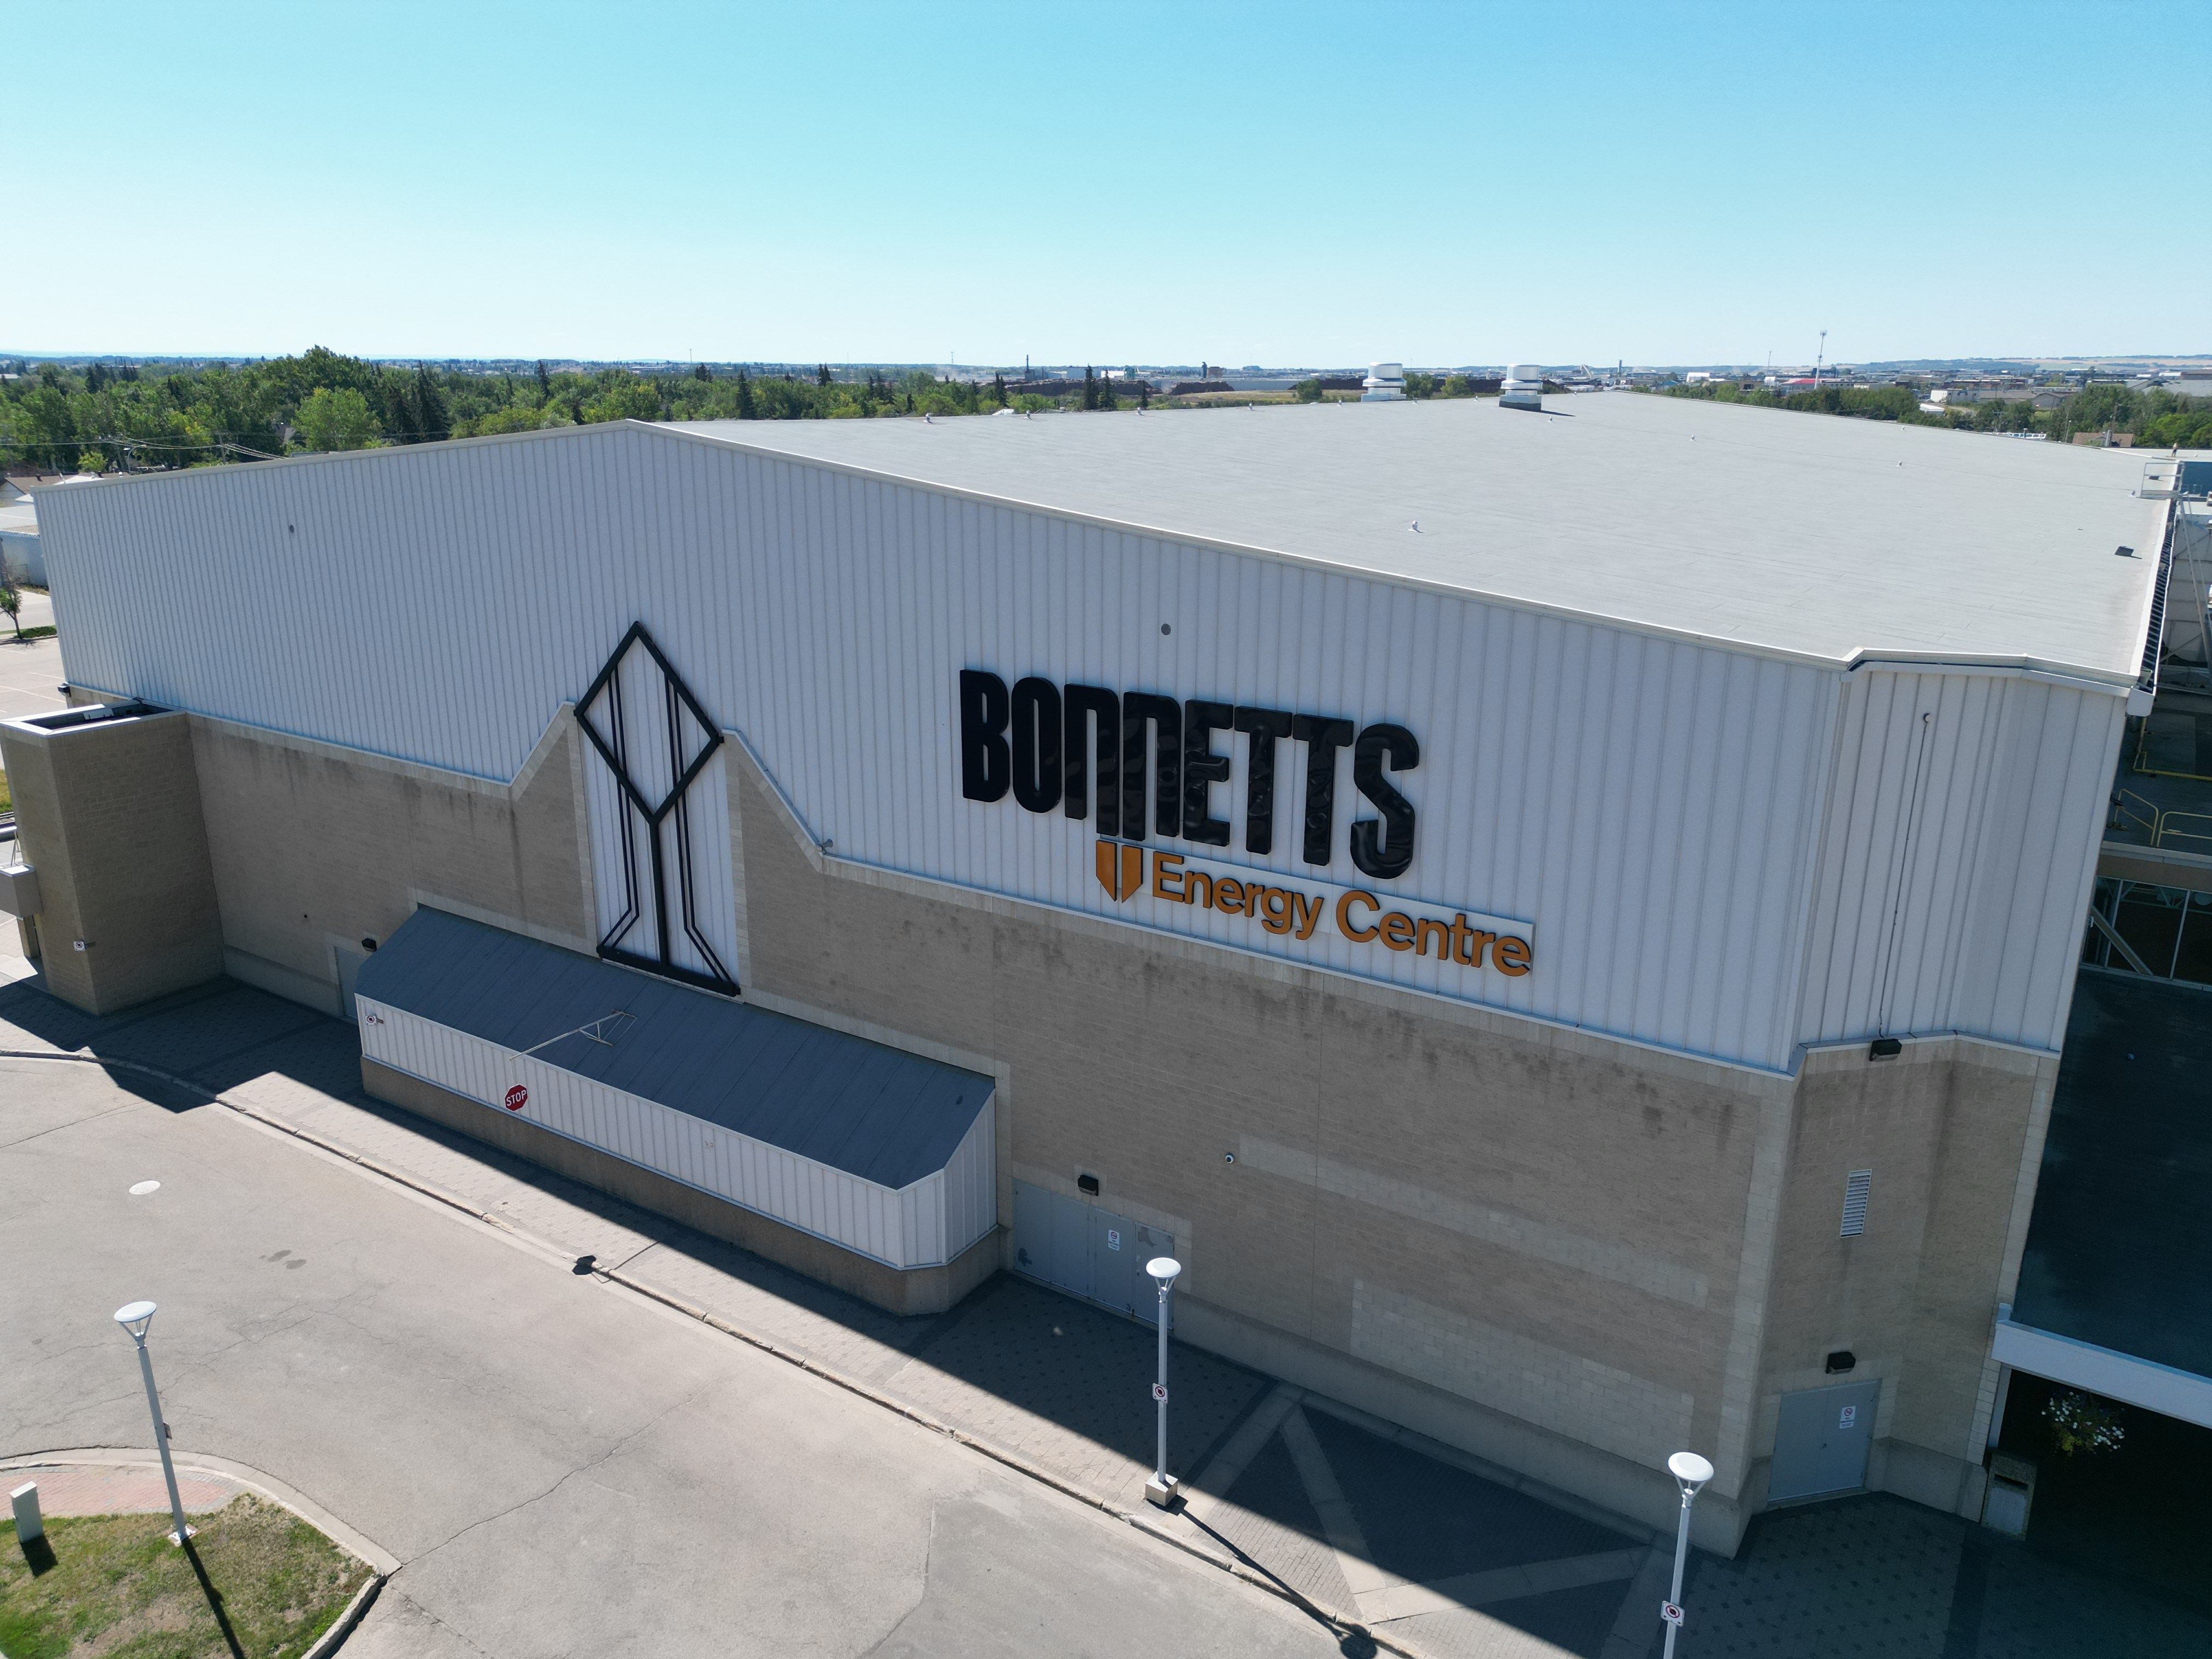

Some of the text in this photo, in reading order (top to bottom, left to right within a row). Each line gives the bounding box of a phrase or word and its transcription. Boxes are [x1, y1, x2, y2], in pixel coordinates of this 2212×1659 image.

[960, 669, 1419, 879] BONNETTS
[1152, 850, 1532, 977] Energy Centre
[506, 1090, 526, 1106] STOP
